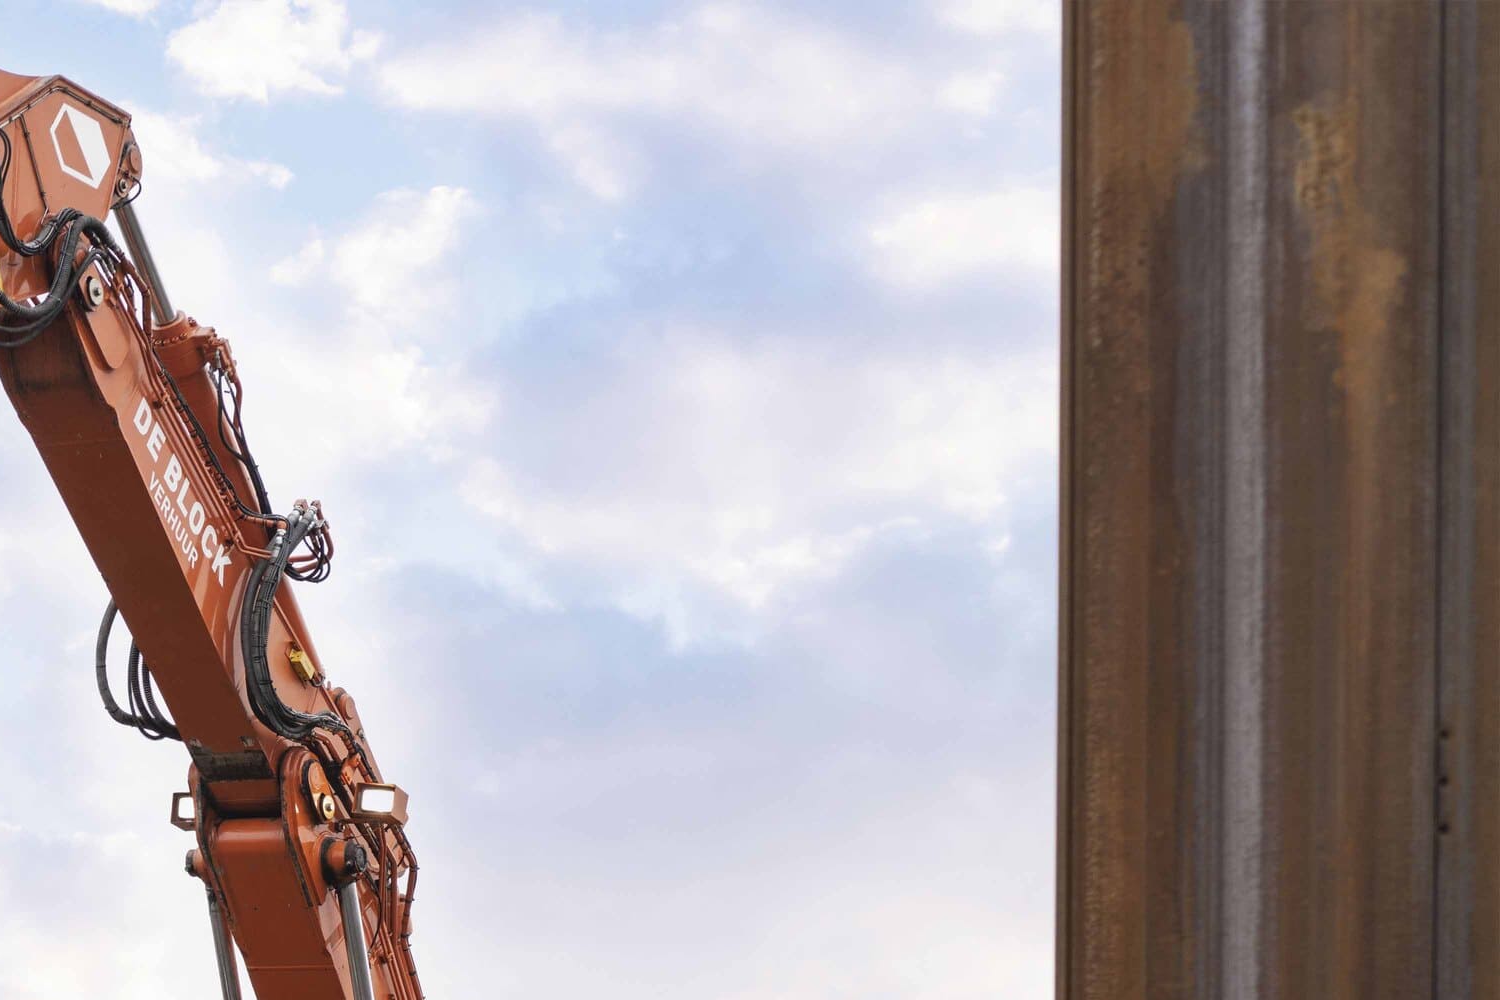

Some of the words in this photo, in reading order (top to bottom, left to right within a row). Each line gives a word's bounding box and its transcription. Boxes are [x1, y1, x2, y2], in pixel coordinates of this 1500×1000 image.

[133, 397, 167, 462] DE
[163, 454, 233, 588] BLOCK
[148, 470, 200, 569] VERHUUR
